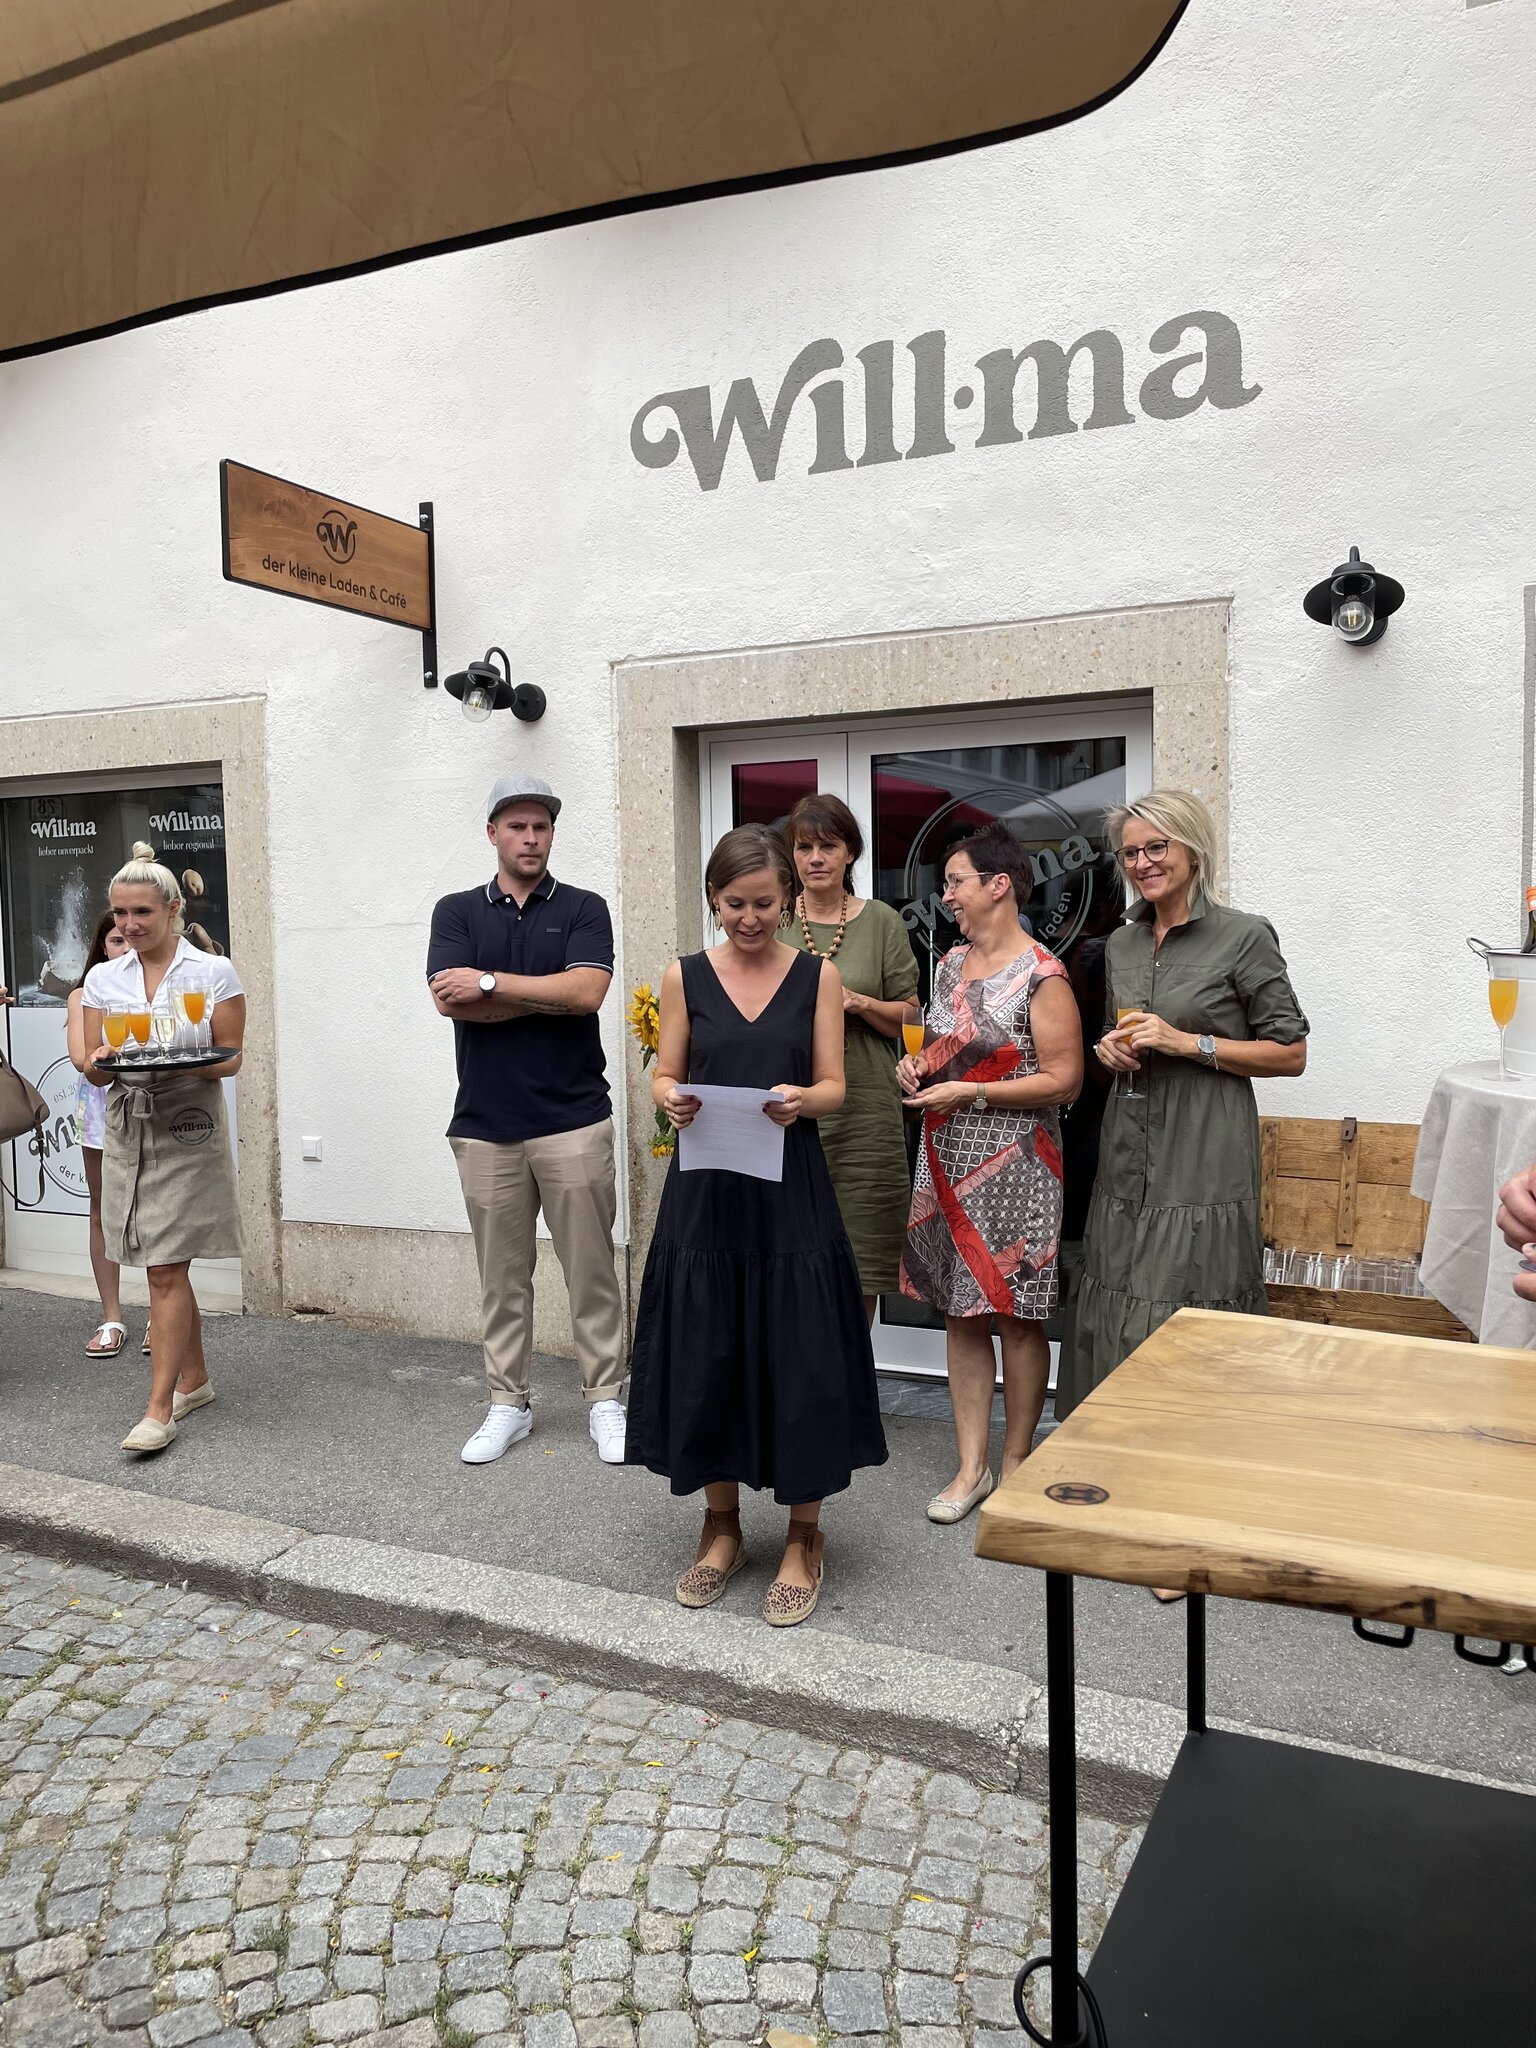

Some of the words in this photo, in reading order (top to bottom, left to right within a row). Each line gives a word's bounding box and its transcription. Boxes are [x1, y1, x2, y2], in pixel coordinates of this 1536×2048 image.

[316, 521, 358, 554] W
[262, 554, 286, 574] der
[289, 561, 327, 586] kleine
[329, 573, 367, 598] Laden
[369, 585, 378, 601] &
[379, 589, 407, 609] Café
[38, 846, 57, 857] lieber
[57, 844, 94, 858] unverpackt
[163, 840, 184, 851] lieber
[185, 838, 215, 852] regional
[1038, 891, 1072, 940] laden
[59, 1165, 76, 1180] der
